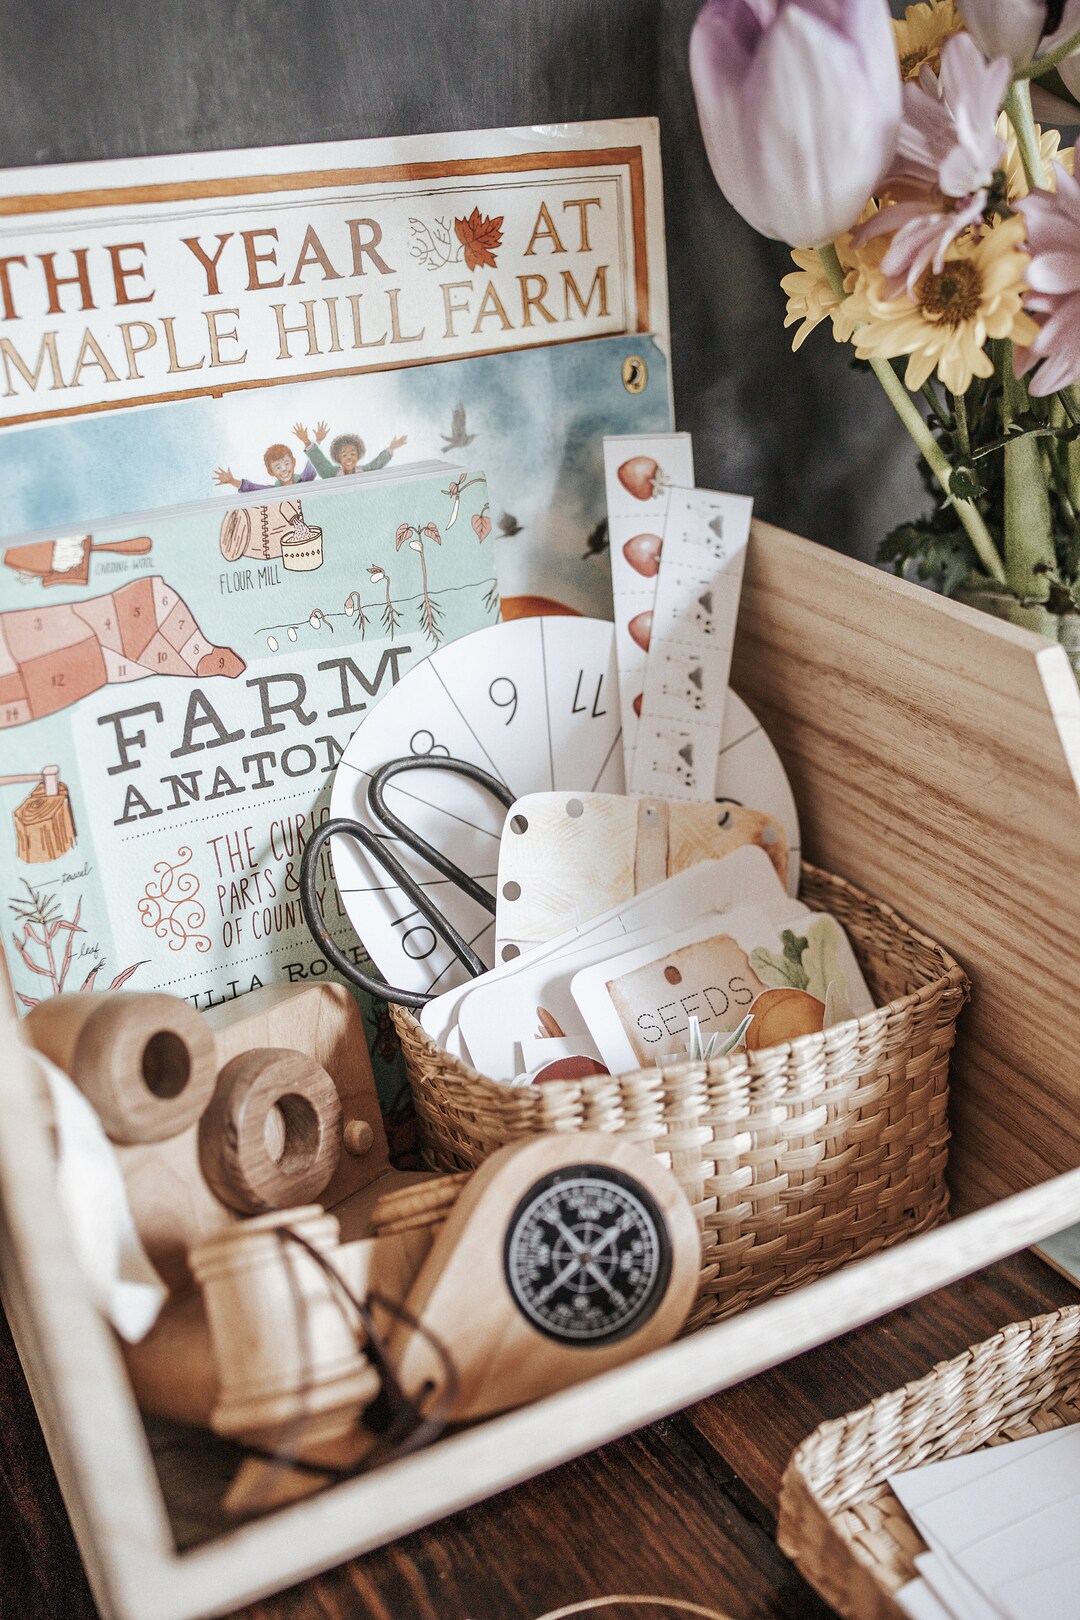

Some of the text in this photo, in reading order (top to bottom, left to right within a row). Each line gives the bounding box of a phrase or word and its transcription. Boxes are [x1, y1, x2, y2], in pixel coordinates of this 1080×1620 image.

[0, 197, 601, 321] THE YEAR AT
[0, 264, 611, 397] MAPLE HILL FARM
[219, 564, 281, 595] FLOUR MILL
[162, 595, 169, 606] 6
[133, 607, 141, 619] 5
[104, 618, 112, 631] 4
[178, 619, 185, 630] 7
[157, 651, 168, 664] 10
[193, 644, 200, 655] 8
[118, 665, 127, 677] 11
[218, 657, 225, 669] 9
[51, 673, 65, 687] 12
[97, 646, 412, 775] FARM
[207, 826, 258, 878] THE
[217, 868, 277, 917] PARTS
[284, 862, 300, 893] &
[222, 917, 243, 948] OF
[252, 886, 327, 940] COUNTY
[77, 942, 101, 960] leaf
[637, 976, 754, 1044] SEEDS
